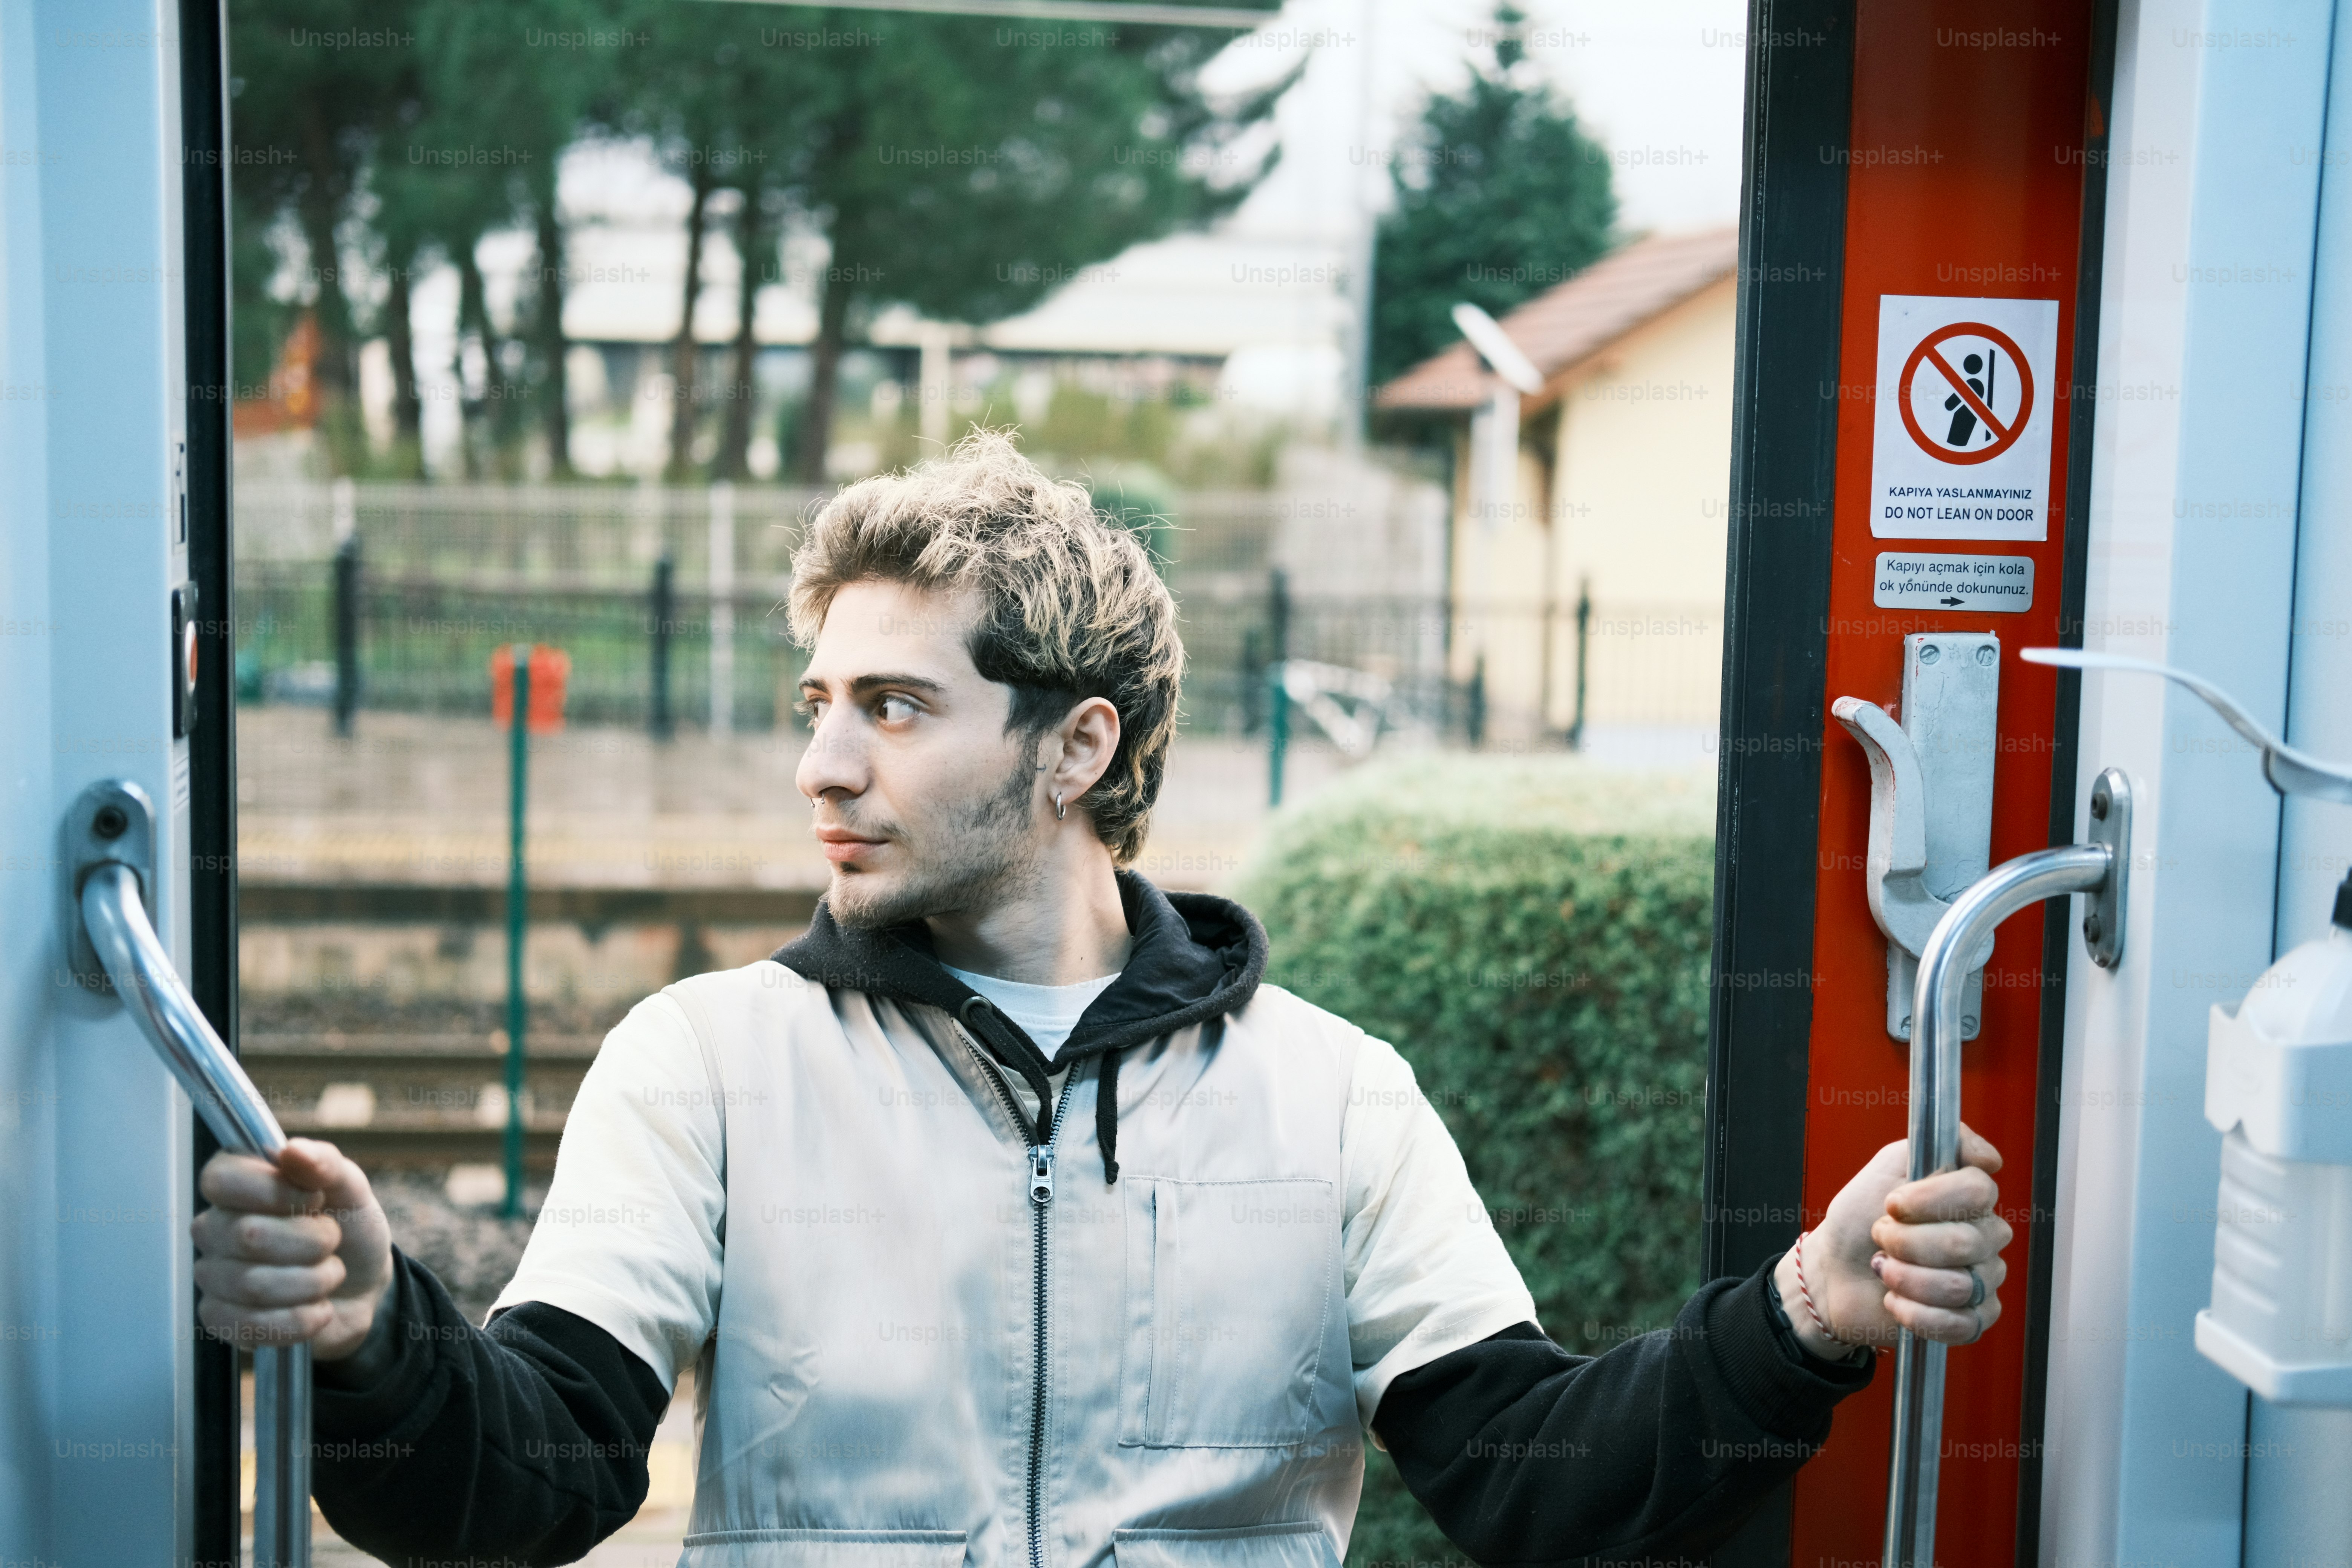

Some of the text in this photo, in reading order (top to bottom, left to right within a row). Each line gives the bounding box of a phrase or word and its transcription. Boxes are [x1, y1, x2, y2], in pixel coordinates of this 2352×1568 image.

[1890, 487, 2032, 499] KAPIYA YASLANMAYINIZ
[1885, 507, 2033, 521] DO NOT LEAN ON DOOR
[1887, 559, 2024, 576] Kapıyı açmak için kola
[1880, 580, 1894, 591] ok
[1957, 582, 2028, 595] dokununuz.
